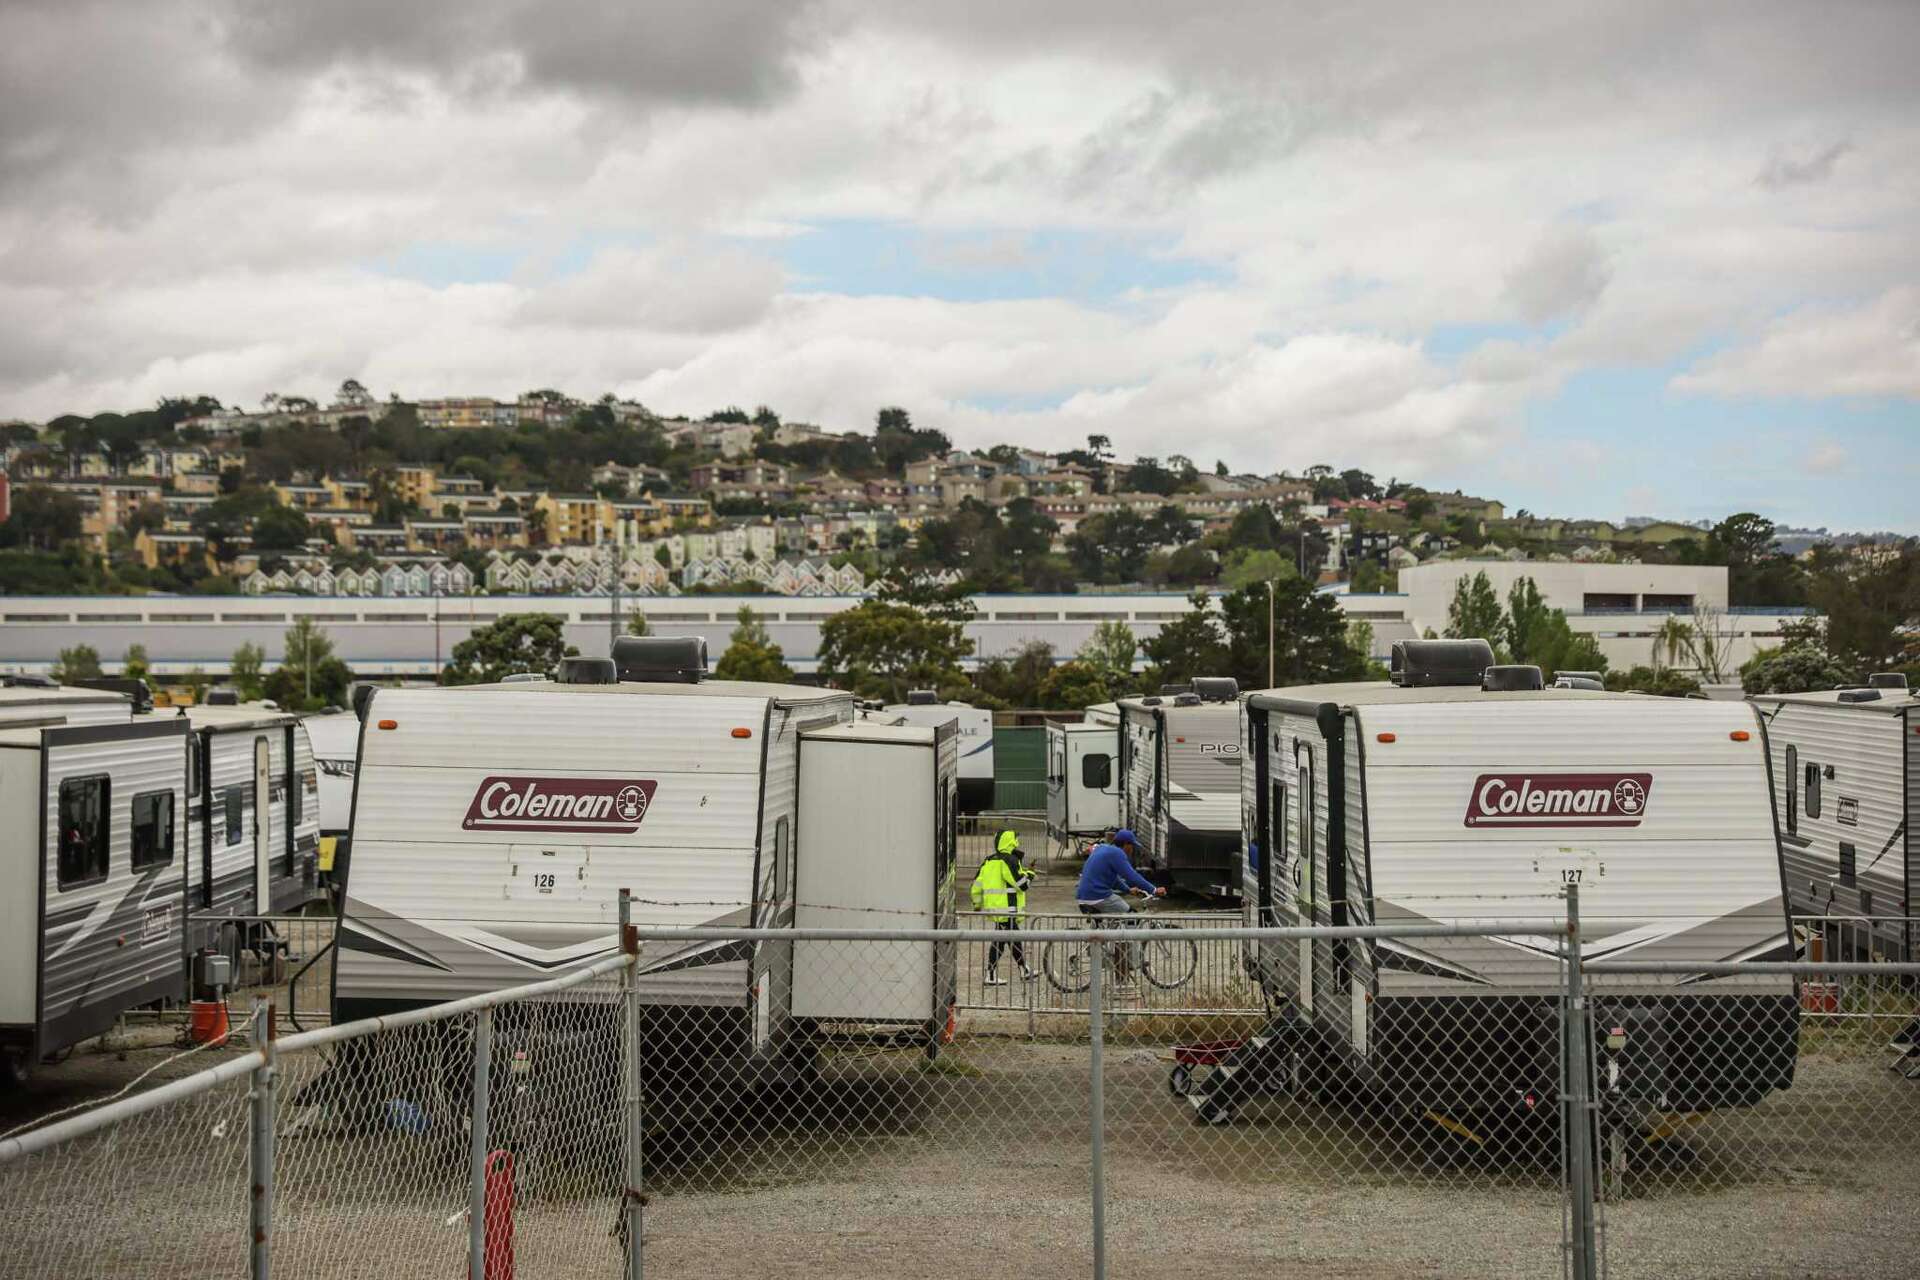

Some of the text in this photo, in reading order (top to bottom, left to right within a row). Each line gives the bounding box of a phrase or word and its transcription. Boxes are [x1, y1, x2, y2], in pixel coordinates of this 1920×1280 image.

[1200, 743, 1240, 754] PIO
[480, 781, 614, 819] Coleman
[1478, 778, 1612, 816] Coleman
[534, 873, 556, 888] 126
[1561, 869, 1583, 883] 127
